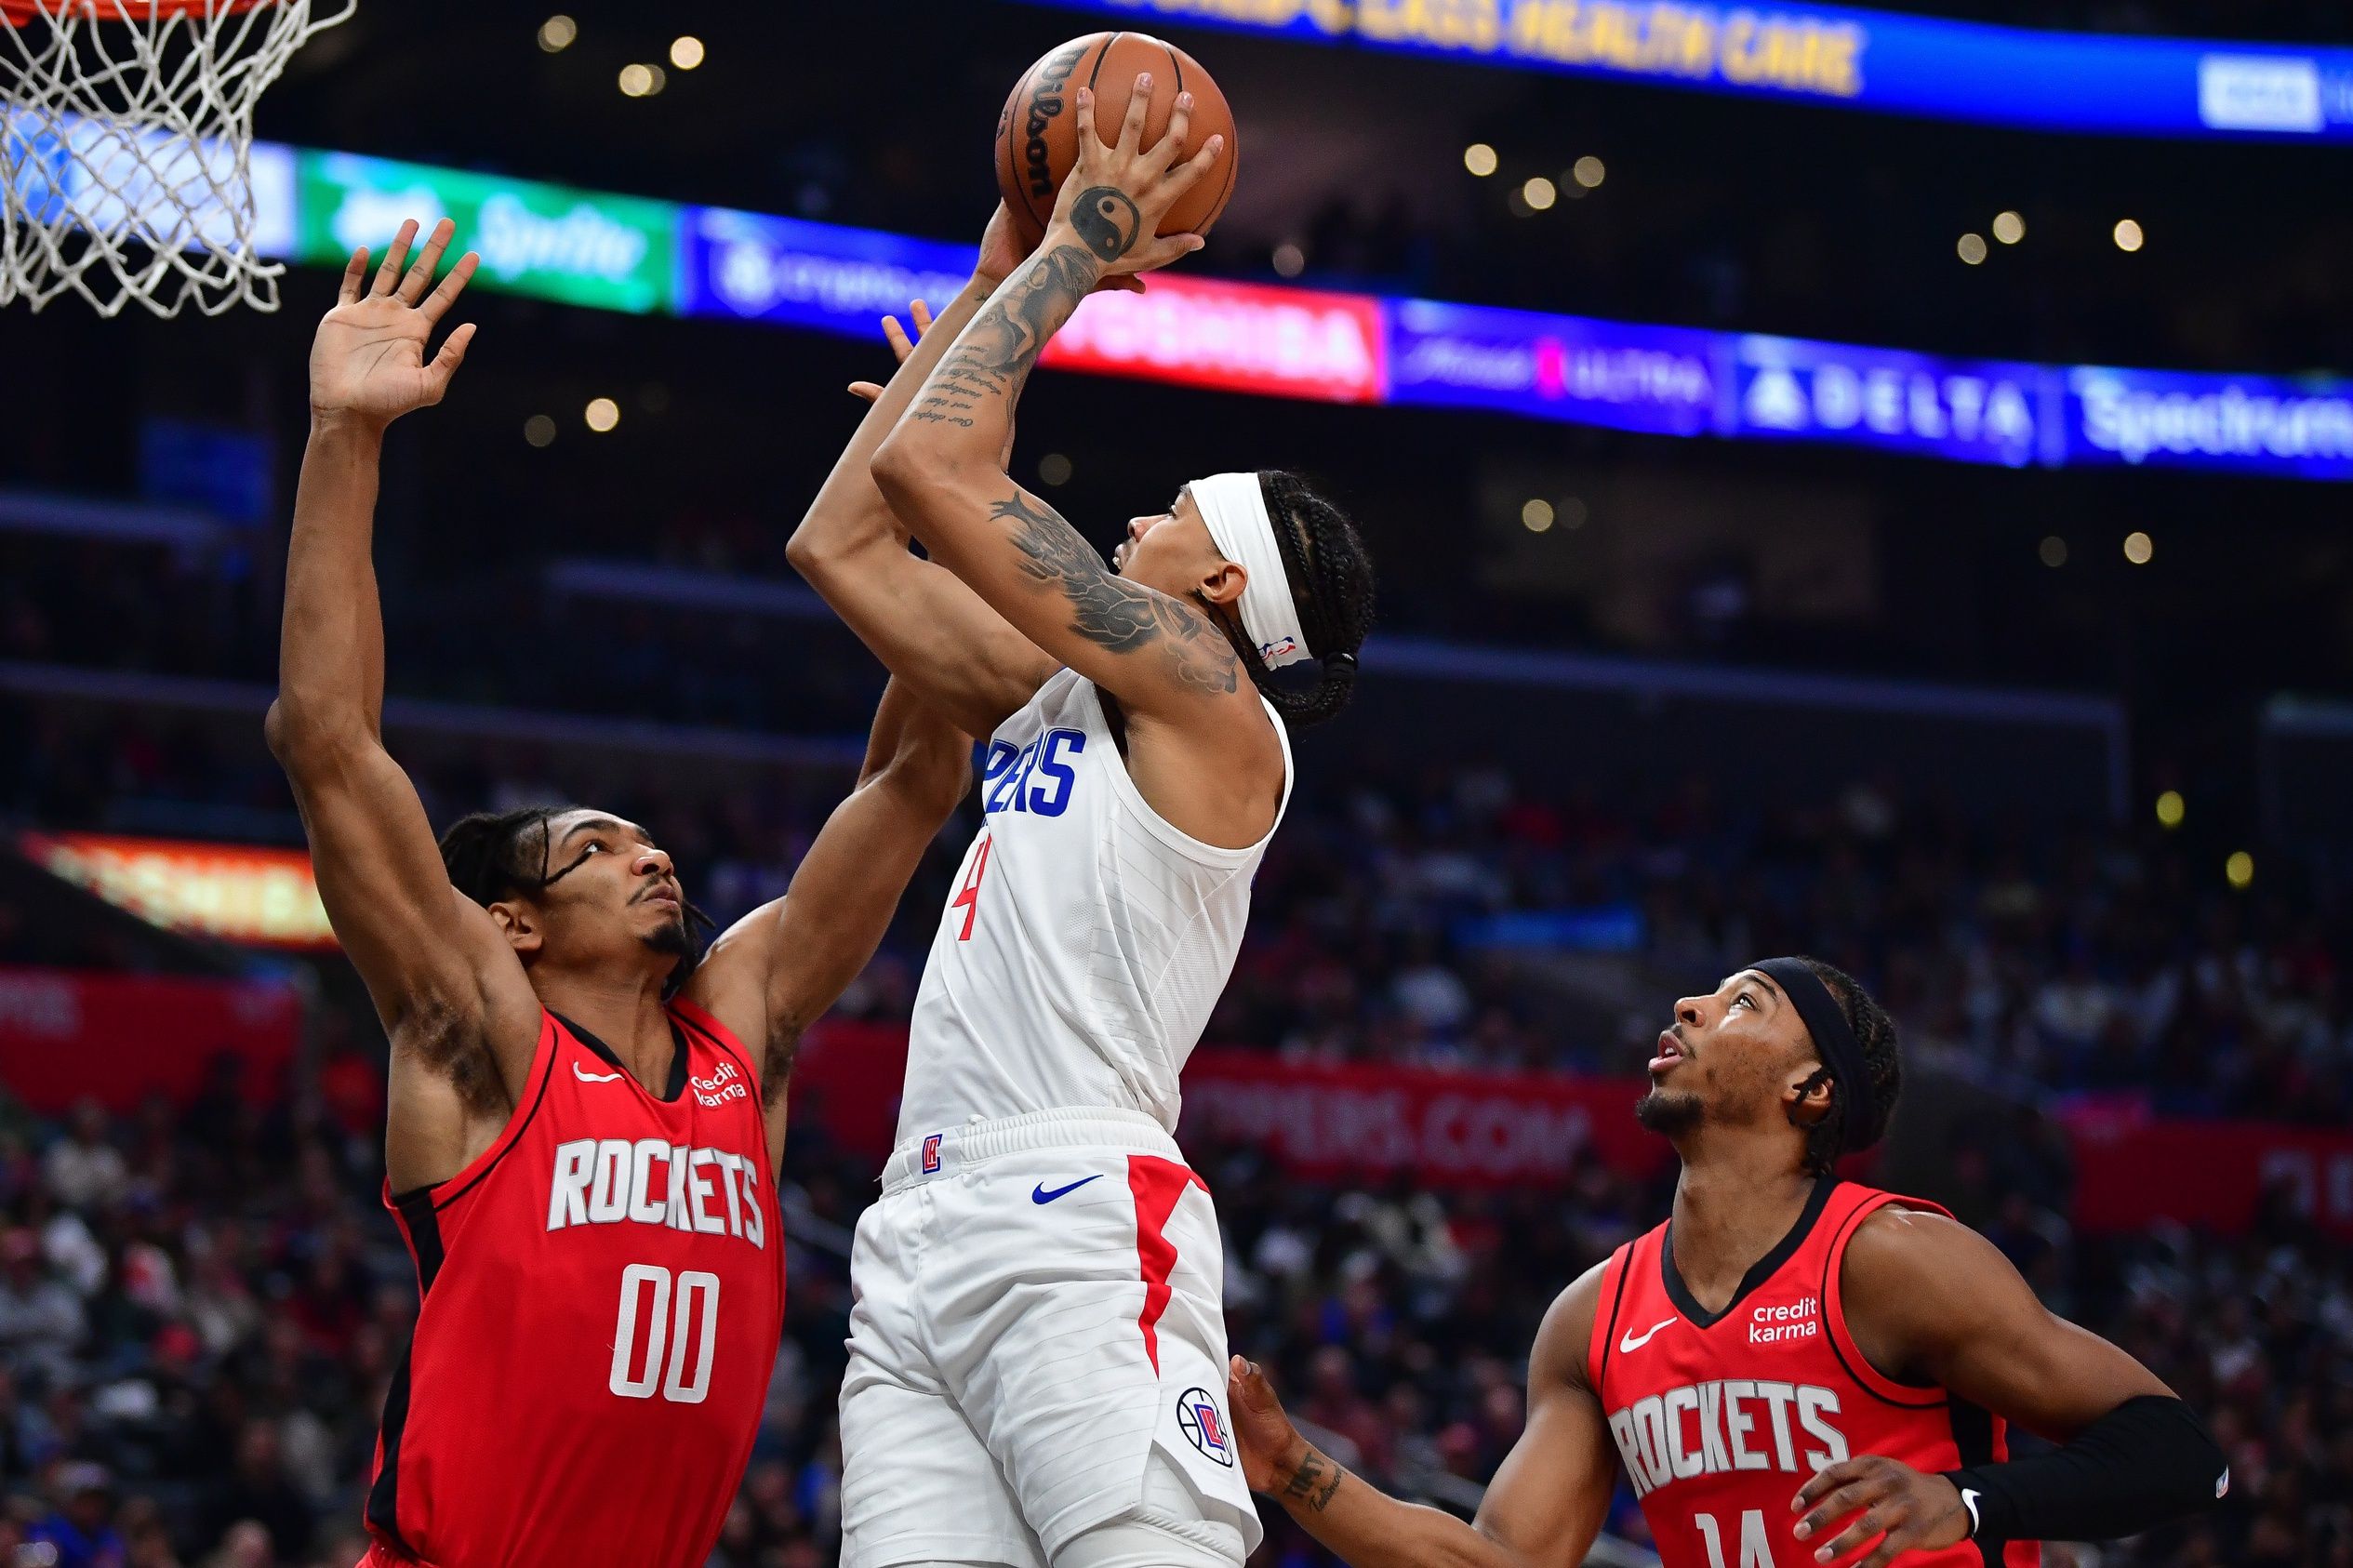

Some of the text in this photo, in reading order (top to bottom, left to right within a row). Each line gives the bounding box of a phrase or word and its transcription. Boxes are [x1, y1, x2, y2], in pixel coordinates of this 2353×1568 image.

[1720, 19, 1863, 97] CARE
[1027, 47, 1090, 198] Wilson
[1810, 364, 2035, 444] DELTA
[951, 832, 992, 941] 4
[693, 1084, 747, 1107] karma
[546, 1138, 765, 1250] ROCKETS
[609, 1263, 720, 1403] 00
[1749, 1321, 1816, 1344] karma
[1753, 1296, 1816, 1322] credit
[1608, 1378, 1851, 1501] ROCKETS
